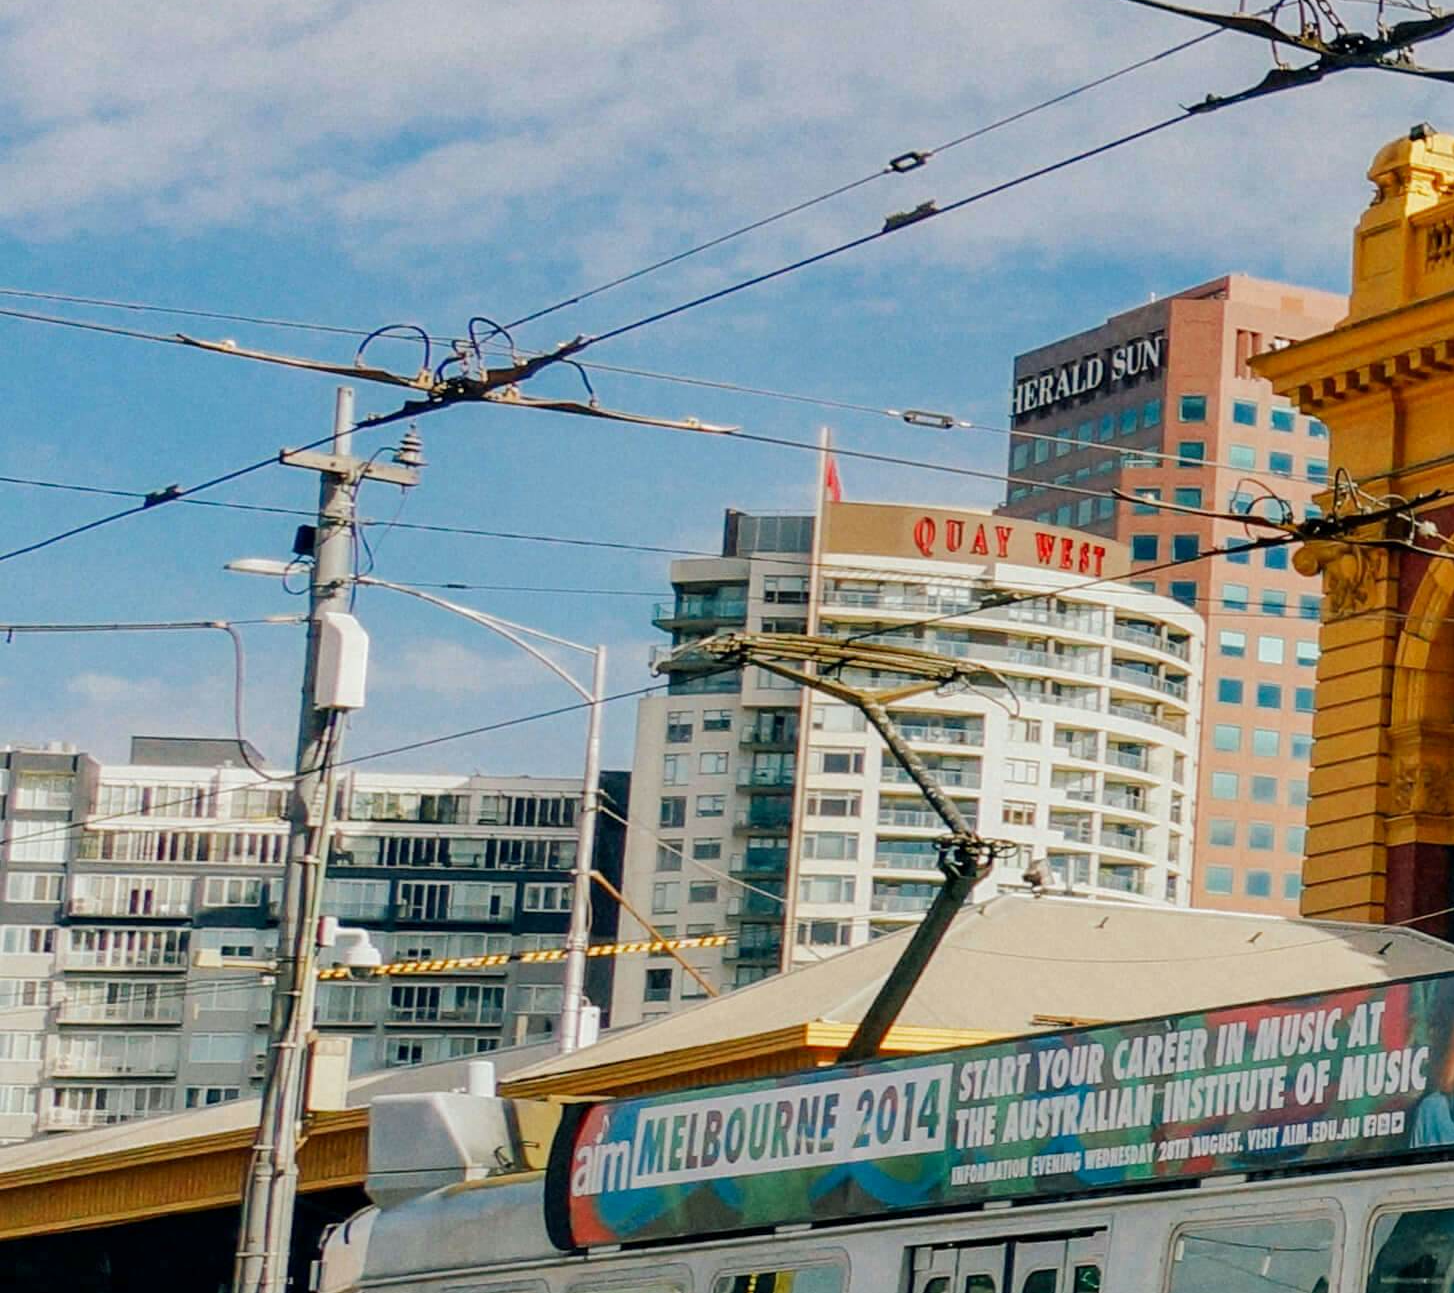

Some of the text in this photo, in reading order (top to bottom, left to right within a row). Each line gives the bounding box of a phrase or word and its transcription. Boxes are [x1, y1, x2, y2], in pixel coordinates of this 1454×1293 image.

[1009, 336, 1167, 414] HERALD SUN
[914, 516, 1106, 577] QUAY WEST
[958, 1001, 1385, 1101] START YOUR CAREER IN MUSIC AT
[636, 1078, 942, 1176] MELBOURNE 2014
[955, 1046, 1430, 1149] THE AUSTRALIAN INSTITUTE OF MUSIC
[572, 1116, 633, 1196] aim
[951, 1156, 1029, 1186] INFORMATION
[1031, 1151, 1081, 1176] EVENING
[1084, 1142, 1156, 1170] WEDNESDAY
[1157, 1137, 1190, 1162] 28TH
[1247, 1126, 1279, 1151] VISIT
[1281, 1116, 1360, 1147] AIM.EDU.AU
